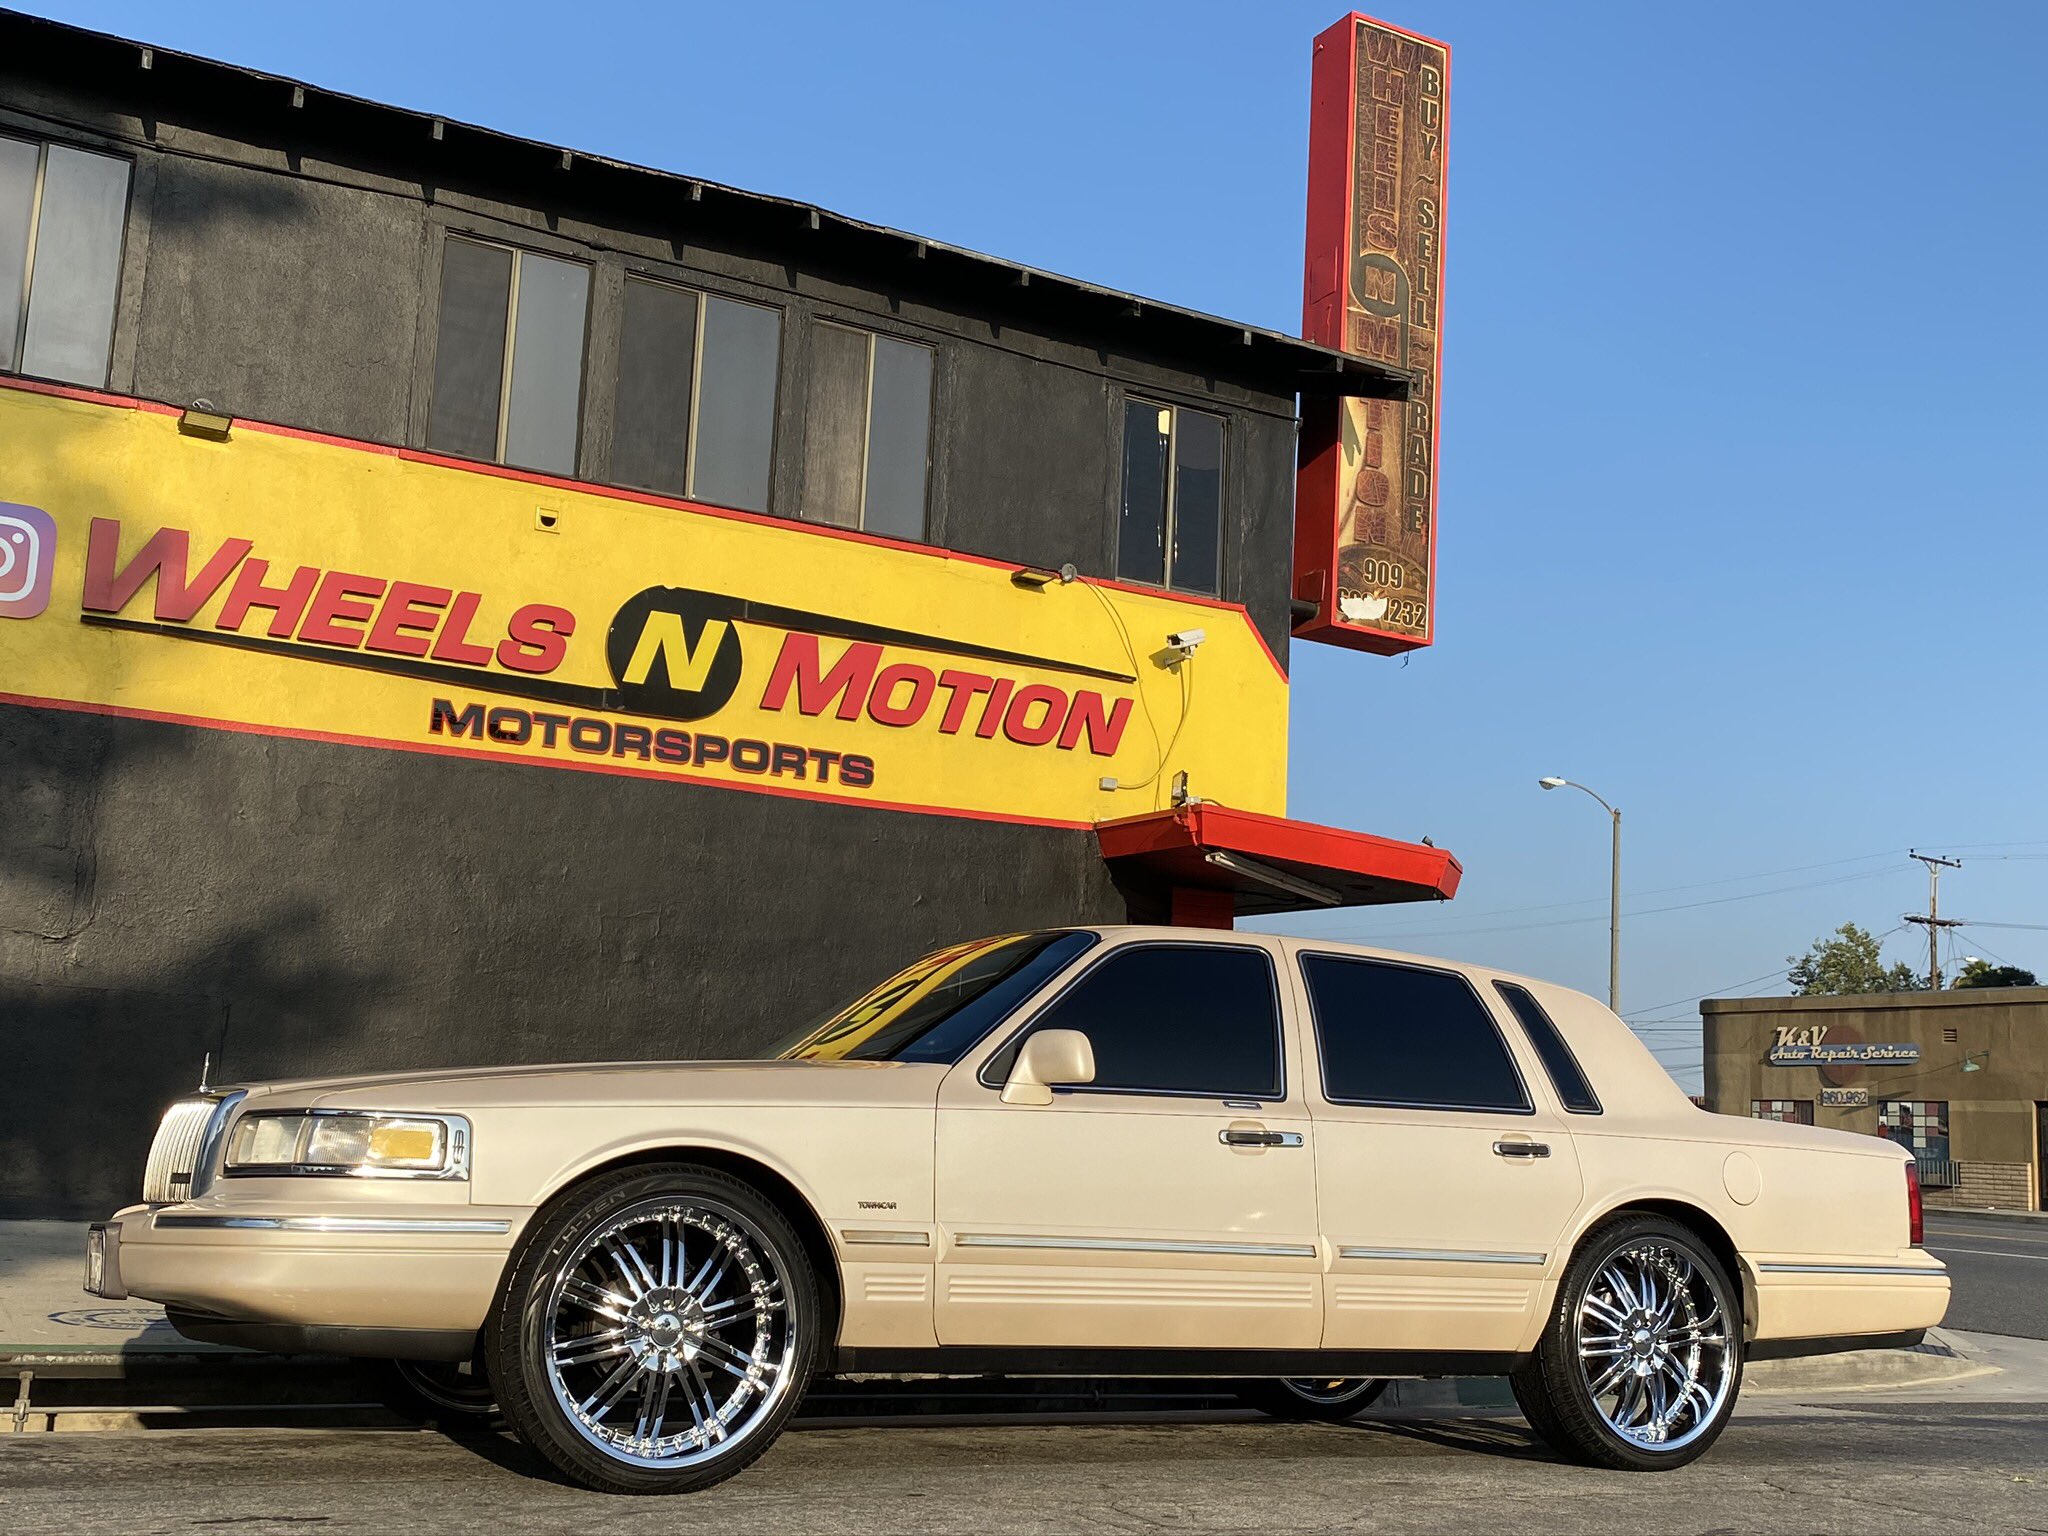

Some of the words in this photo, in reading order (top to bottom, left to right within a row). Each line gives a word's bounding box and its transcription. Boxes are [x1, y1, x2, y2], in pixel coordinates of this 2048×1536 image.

[1363, 27, 1416, 251] WHEELS
[1420, 64, 1440, 162] BUY
[1365, 265, 1396, 305] N
[1415, 198, 1435, 329] SELL
[1354, 317, 1399, 546] MTION
[1407, 365, 1430, 534] TRADE
[1363, 557, 1404, 590] 909
[82, 516, 577, 674] WHEELS
[622, 610, 730, 692] N
[759, 632, 1135, 757] MOTION
[428, 698, 876, 789] MOTORSPORTS
[1770, 1047, 1808, 1060] Auto
[1810, 1046, 1859, 1062] Repair
[1776, 1025, 1828, 1046] K&V
